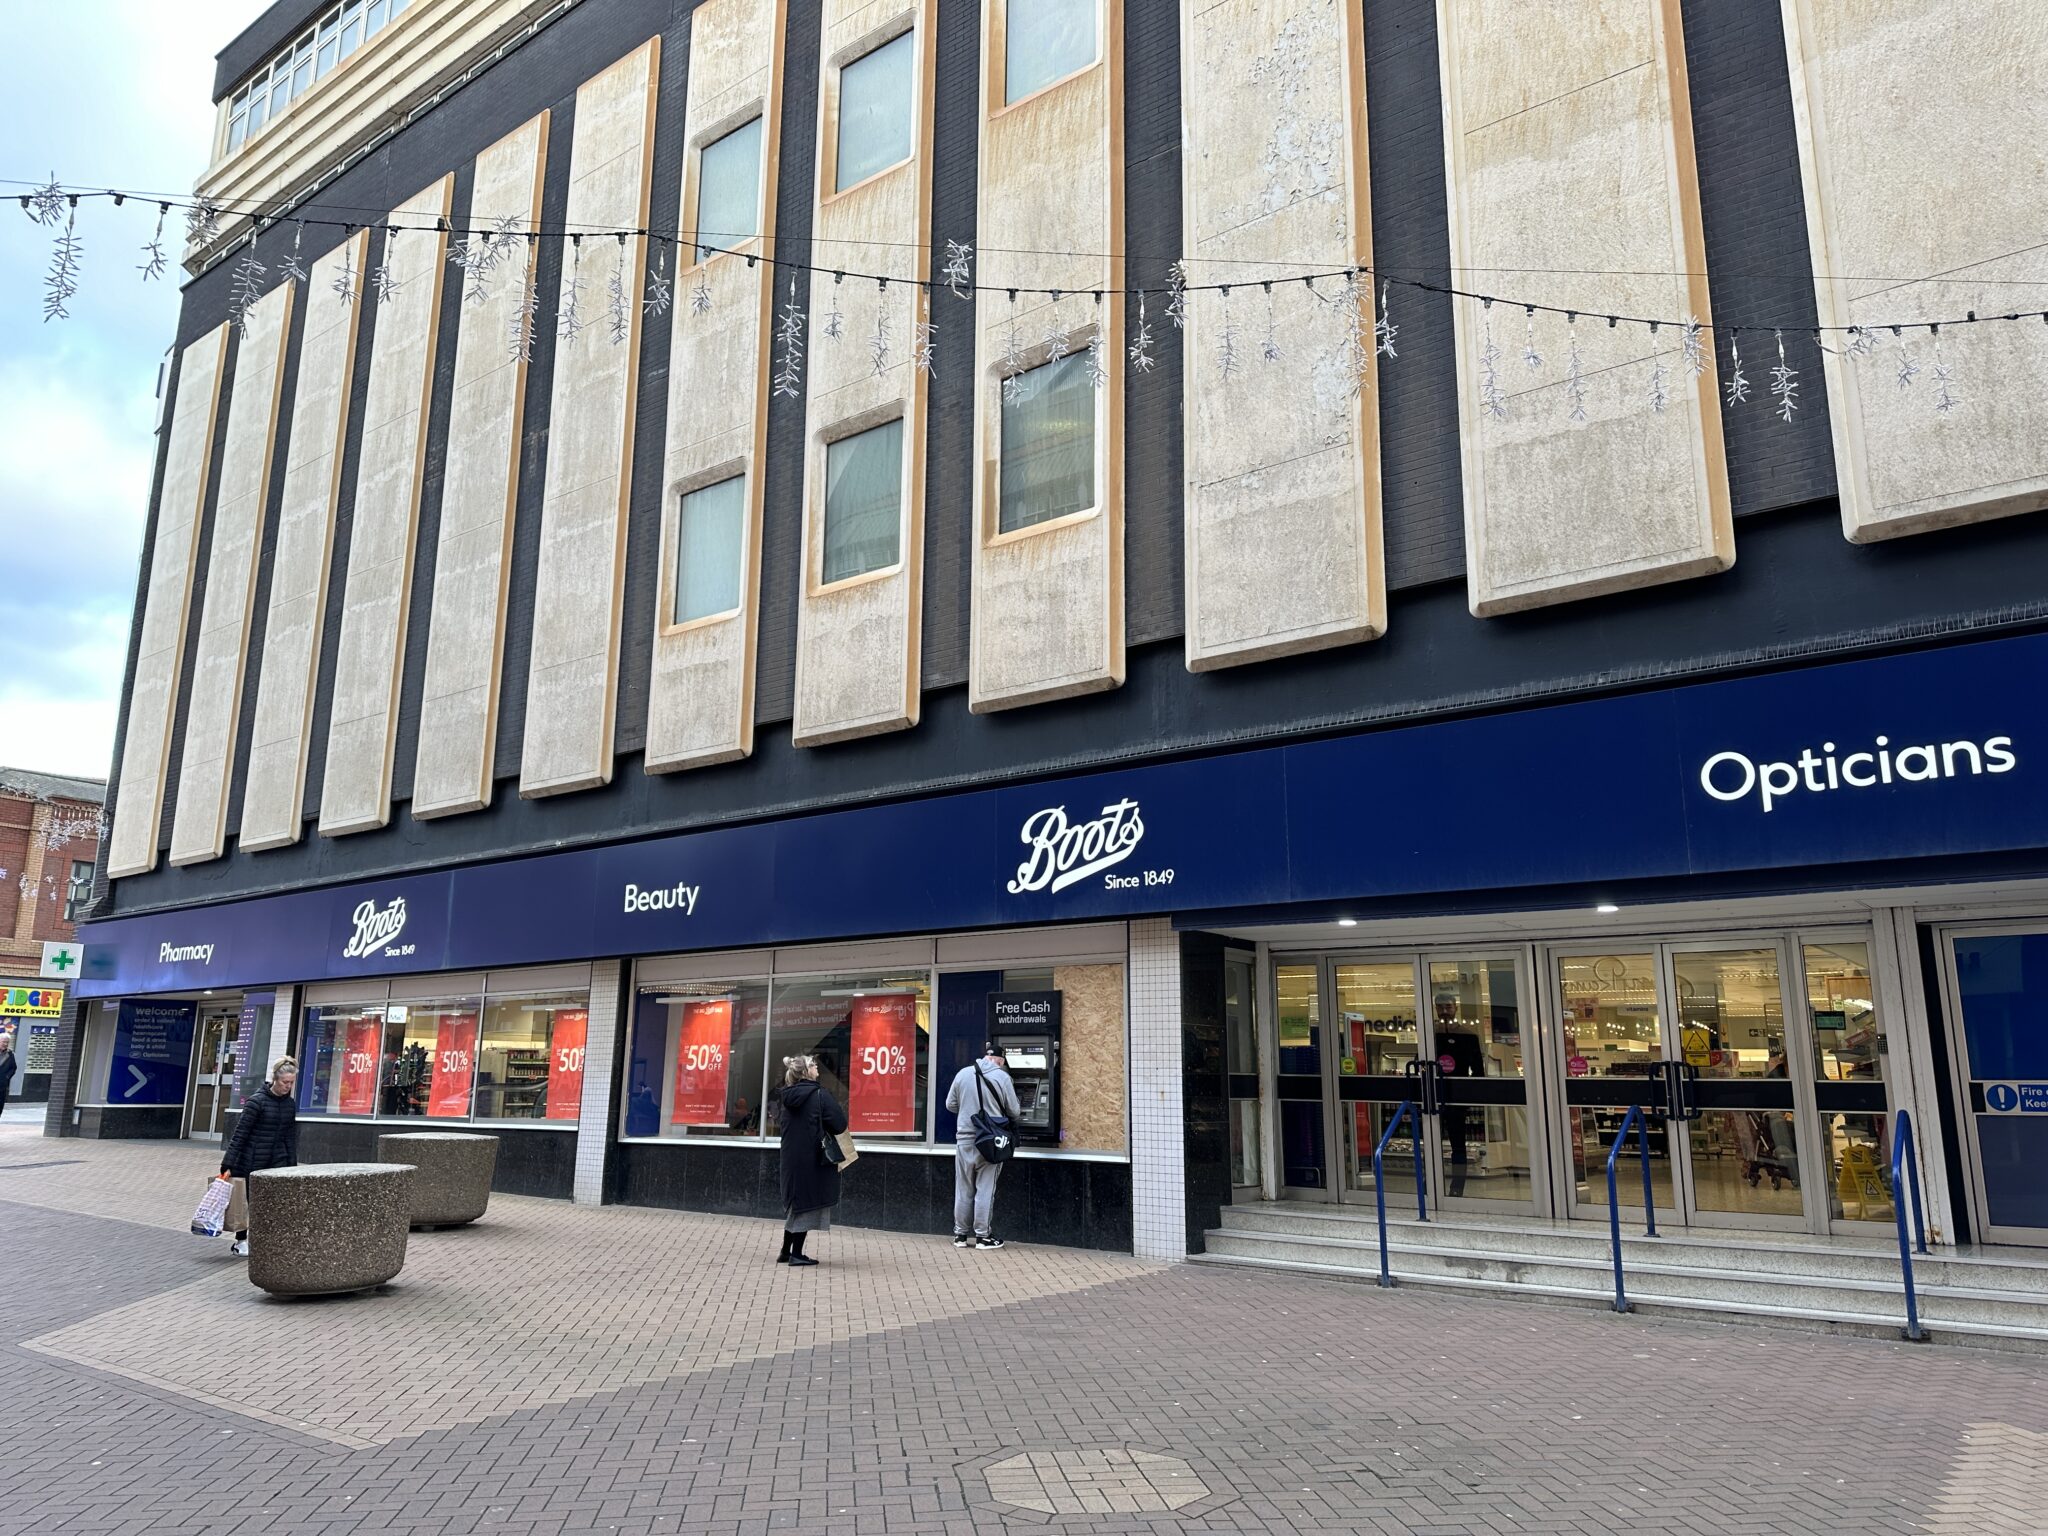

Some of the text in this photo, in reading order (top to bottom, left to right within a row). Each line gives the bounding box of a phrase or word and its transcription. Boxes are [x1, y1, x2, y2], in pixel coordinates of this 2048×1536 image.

[1700, 735, 2016, 813] Opticians
[1006, 797, 1145, 895] Boots
[1104, 869, 1175, 890] Since 1849
[624, 881, 700, 915] Beauty
[343, 896, 406, 959] Boots
[159, 941, 215, 966] Pharmacy
[385, 944, 416, 957] Since 1849
[0, 988, 62, 1008] FIDGET
[995, 1000, 1051, 1014] Free Cash
[4, 1007, 27, 1015] ROCK
[135, 1007, 185, 1016] welcome
[998, 1014, 1047, 1024] withdrawals
[349, 1053, 373, 1073] 50%
[441, 1050, 468, 1073] 50%
[686, 1044, 722, 1071] 50%
[708, 1063, 722, 1071] OFF
[862, 1045, 906, 1075] 50%
[457, 1065, 468, 1073] OFF
[889, 1066, 906, 1075] OFF
[2021, 1087, 2043, 1096] Fire
[2025, 1099, 2048, 1108] Kee
